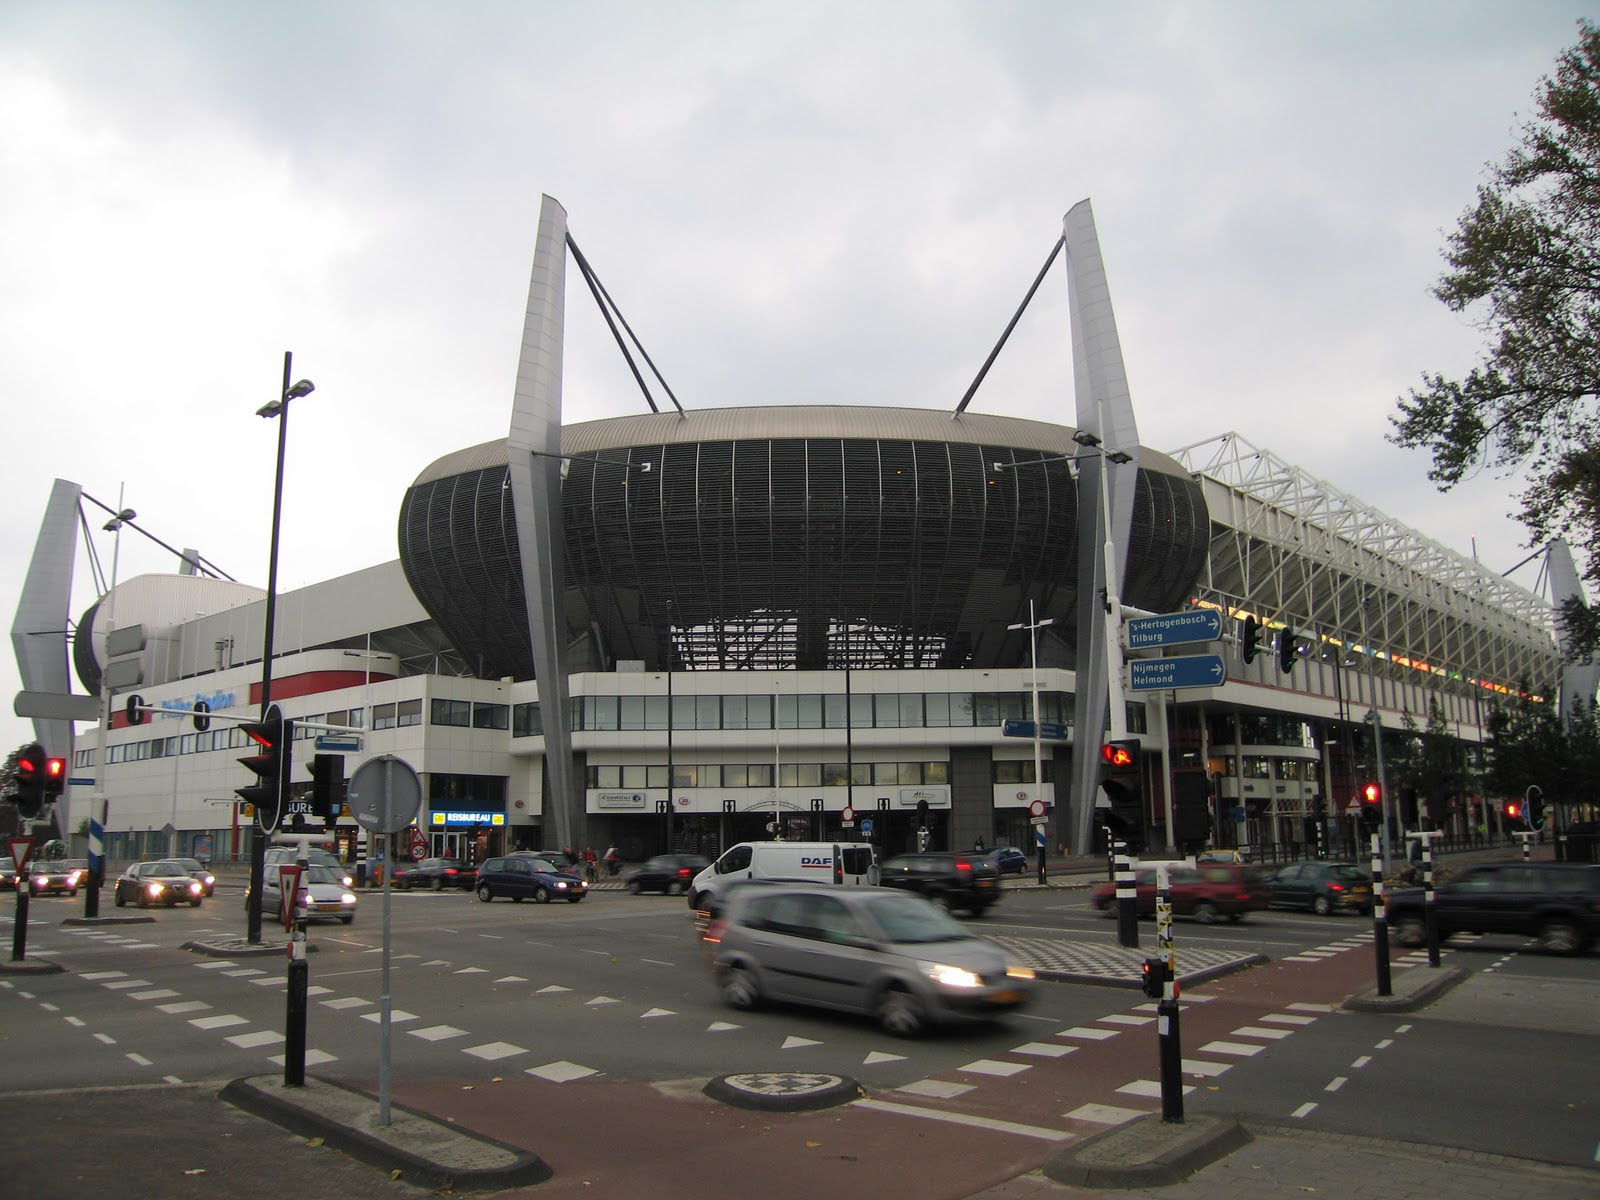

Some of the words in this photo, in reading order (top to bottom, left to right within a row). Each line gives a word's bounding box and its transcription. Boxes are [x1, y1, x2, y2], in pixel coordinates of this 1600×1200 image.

[1131, 614, 1207, 631] 's-Hertogenbosch
[1131, 632, 1163, 643] Tilburg
[1133, 663, 1176, 674] Nijmegen
[1133, 675, 1174, 685] Helmond
[447, 813, 491, 822] REISBUREAU
[801, 857, 832, 865] DAF
